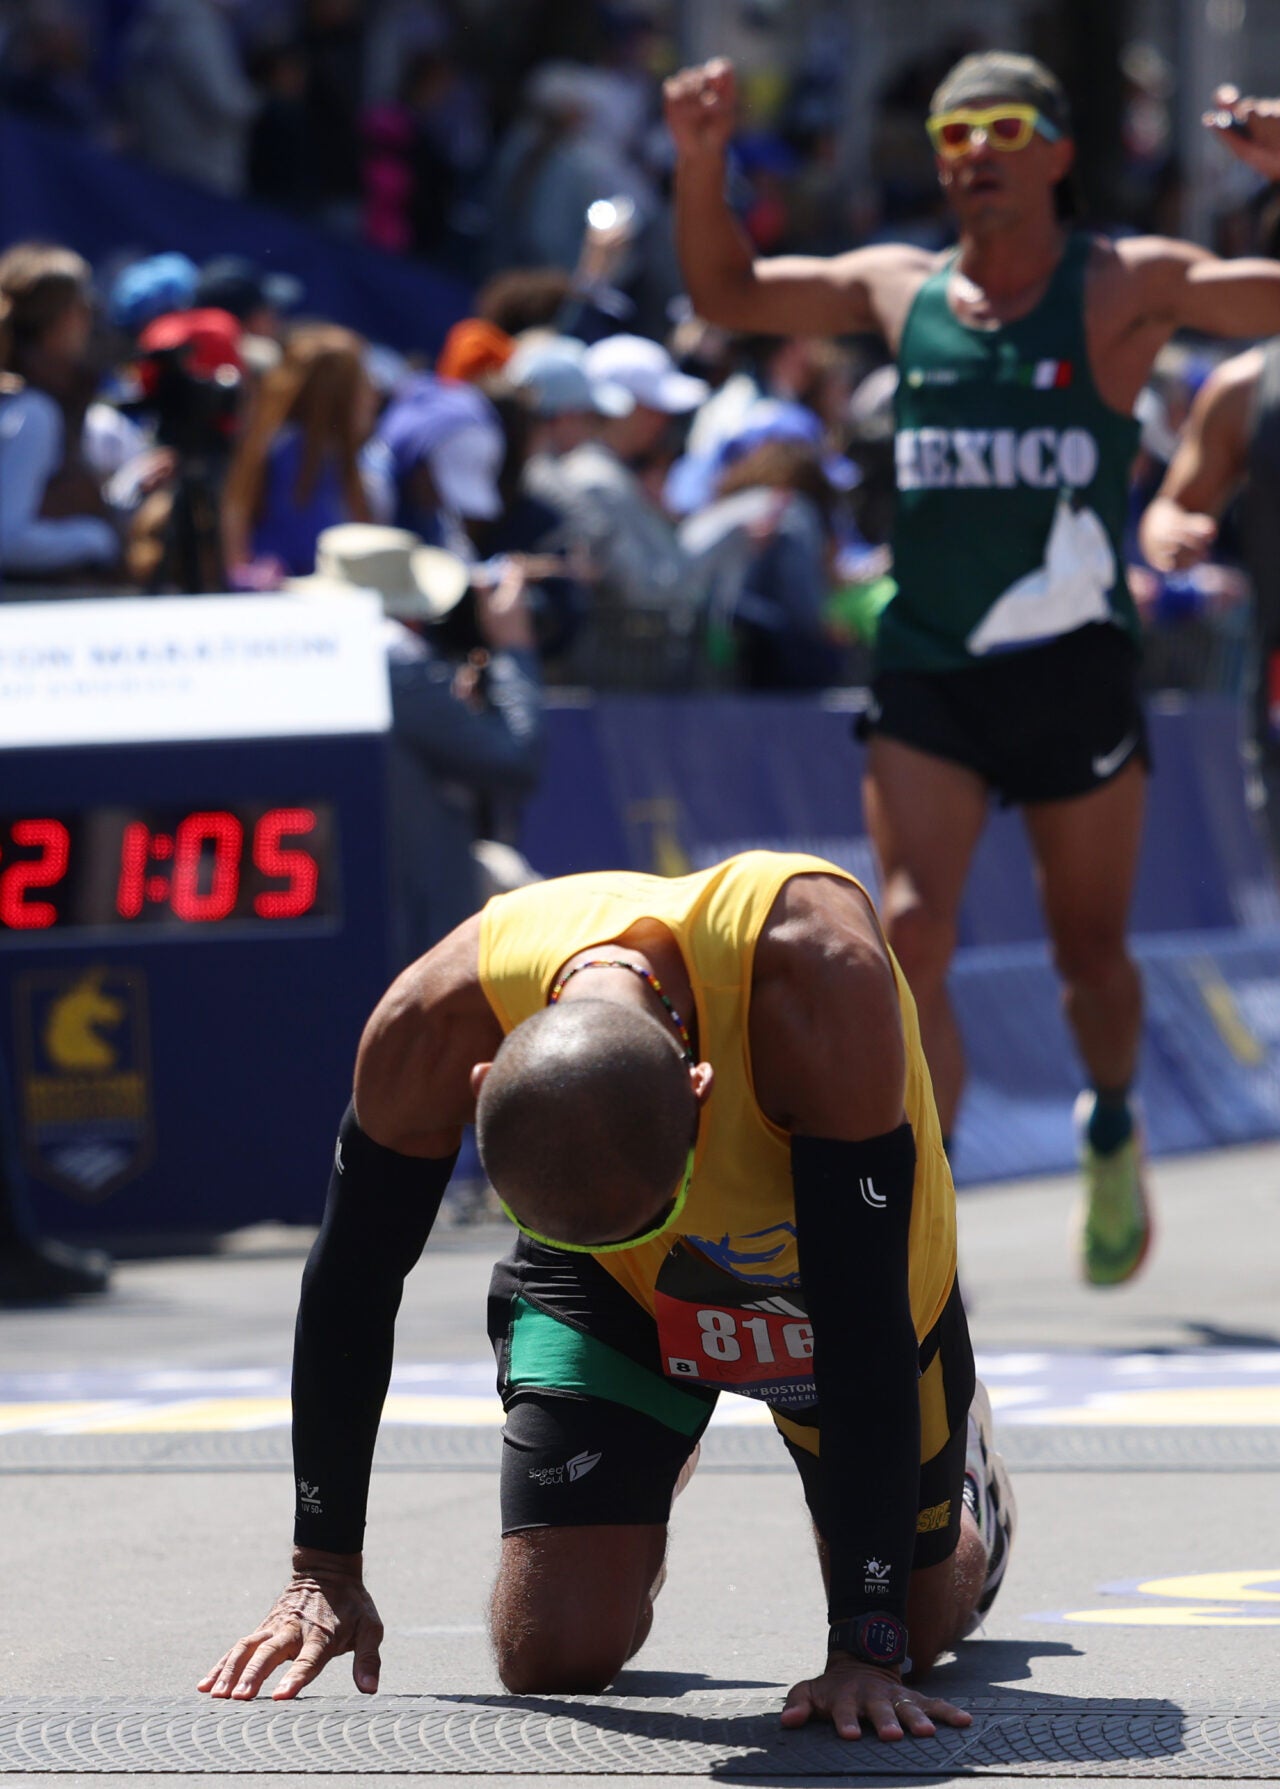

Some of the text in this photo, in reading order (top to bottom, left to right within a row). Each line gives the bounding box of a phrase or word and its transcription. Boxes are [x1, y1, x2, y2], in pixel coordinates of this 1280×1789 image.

[696, 1309, 814, 1363] 816
[676, 1362, 691, 1373] 8
[759, 1382, 817, 1396] BOSTON
[780, 1394, 819, 1403] AMERI
